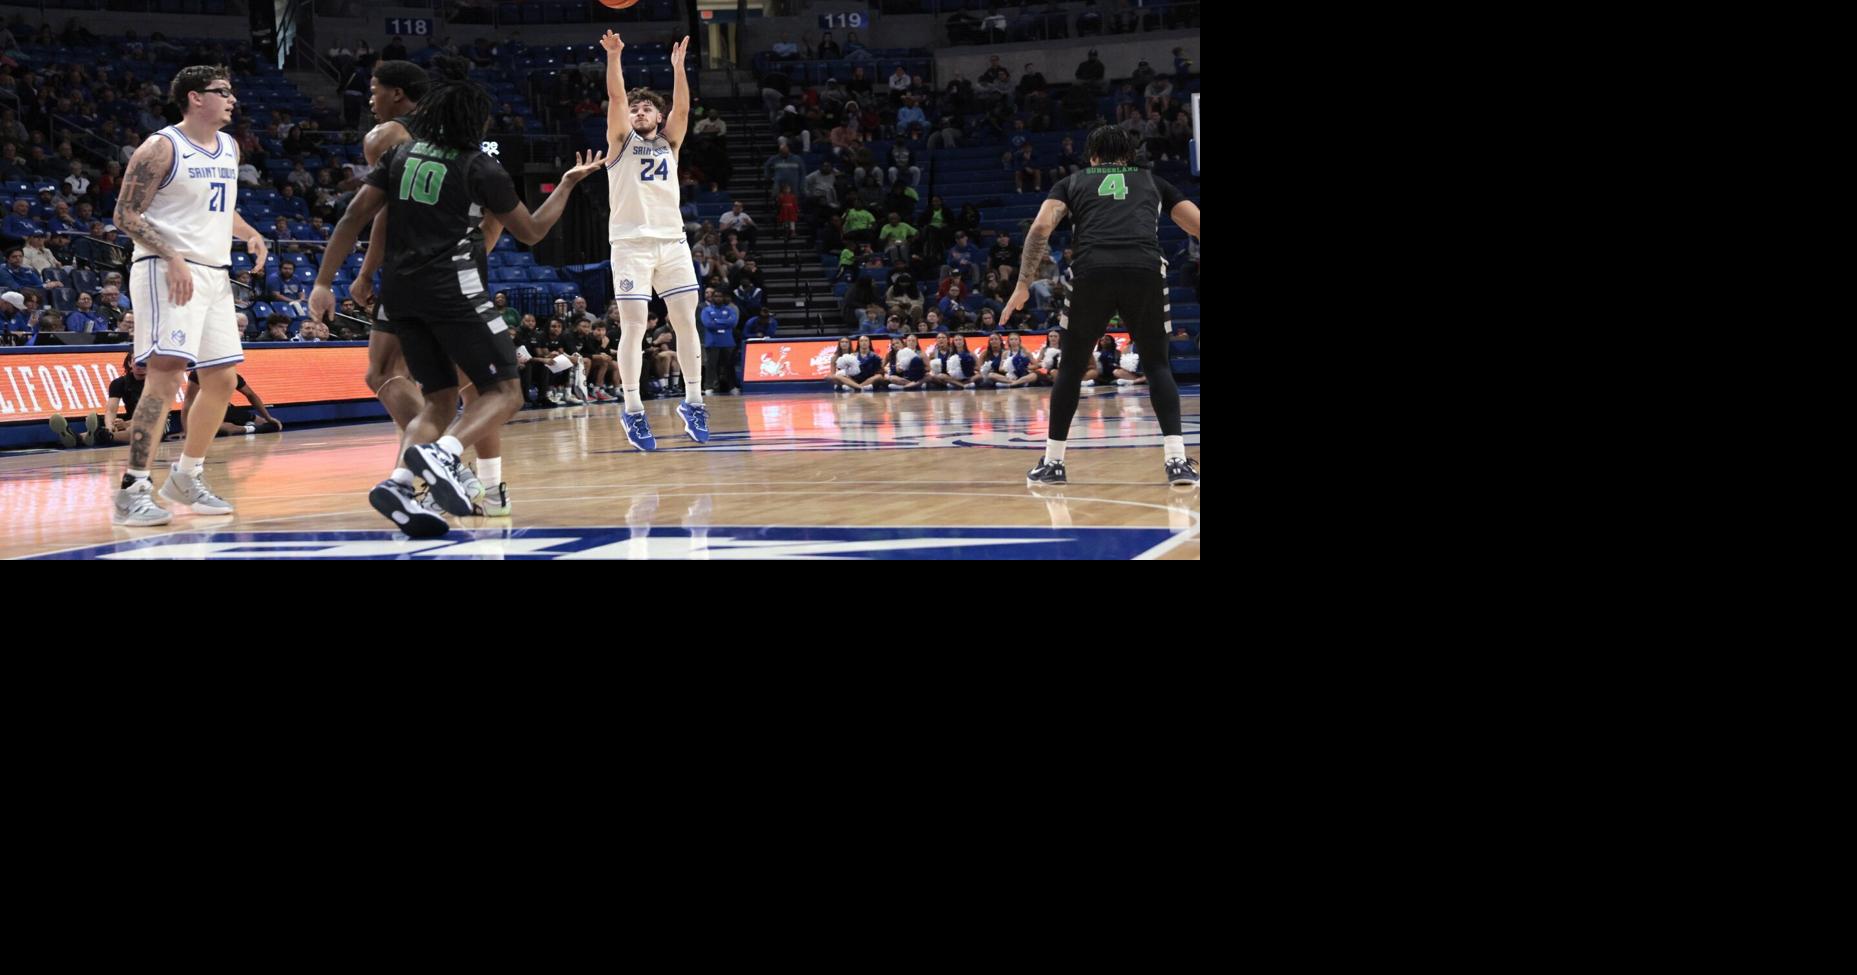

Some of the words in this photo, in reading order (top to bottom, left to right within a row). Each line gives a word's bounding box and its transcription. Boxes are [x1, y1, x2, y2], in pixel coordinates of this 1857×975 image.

[391, 19, 427, 35] 118
[825, 12, 861, 29] 119
[188, 167, 216, 178] SAINT
[640, 158, 669, 181] 24
[399, 157, 448, 206] 10
[1097, 173, 1129, 200] 4
[208, 182, 226, 212] 21
